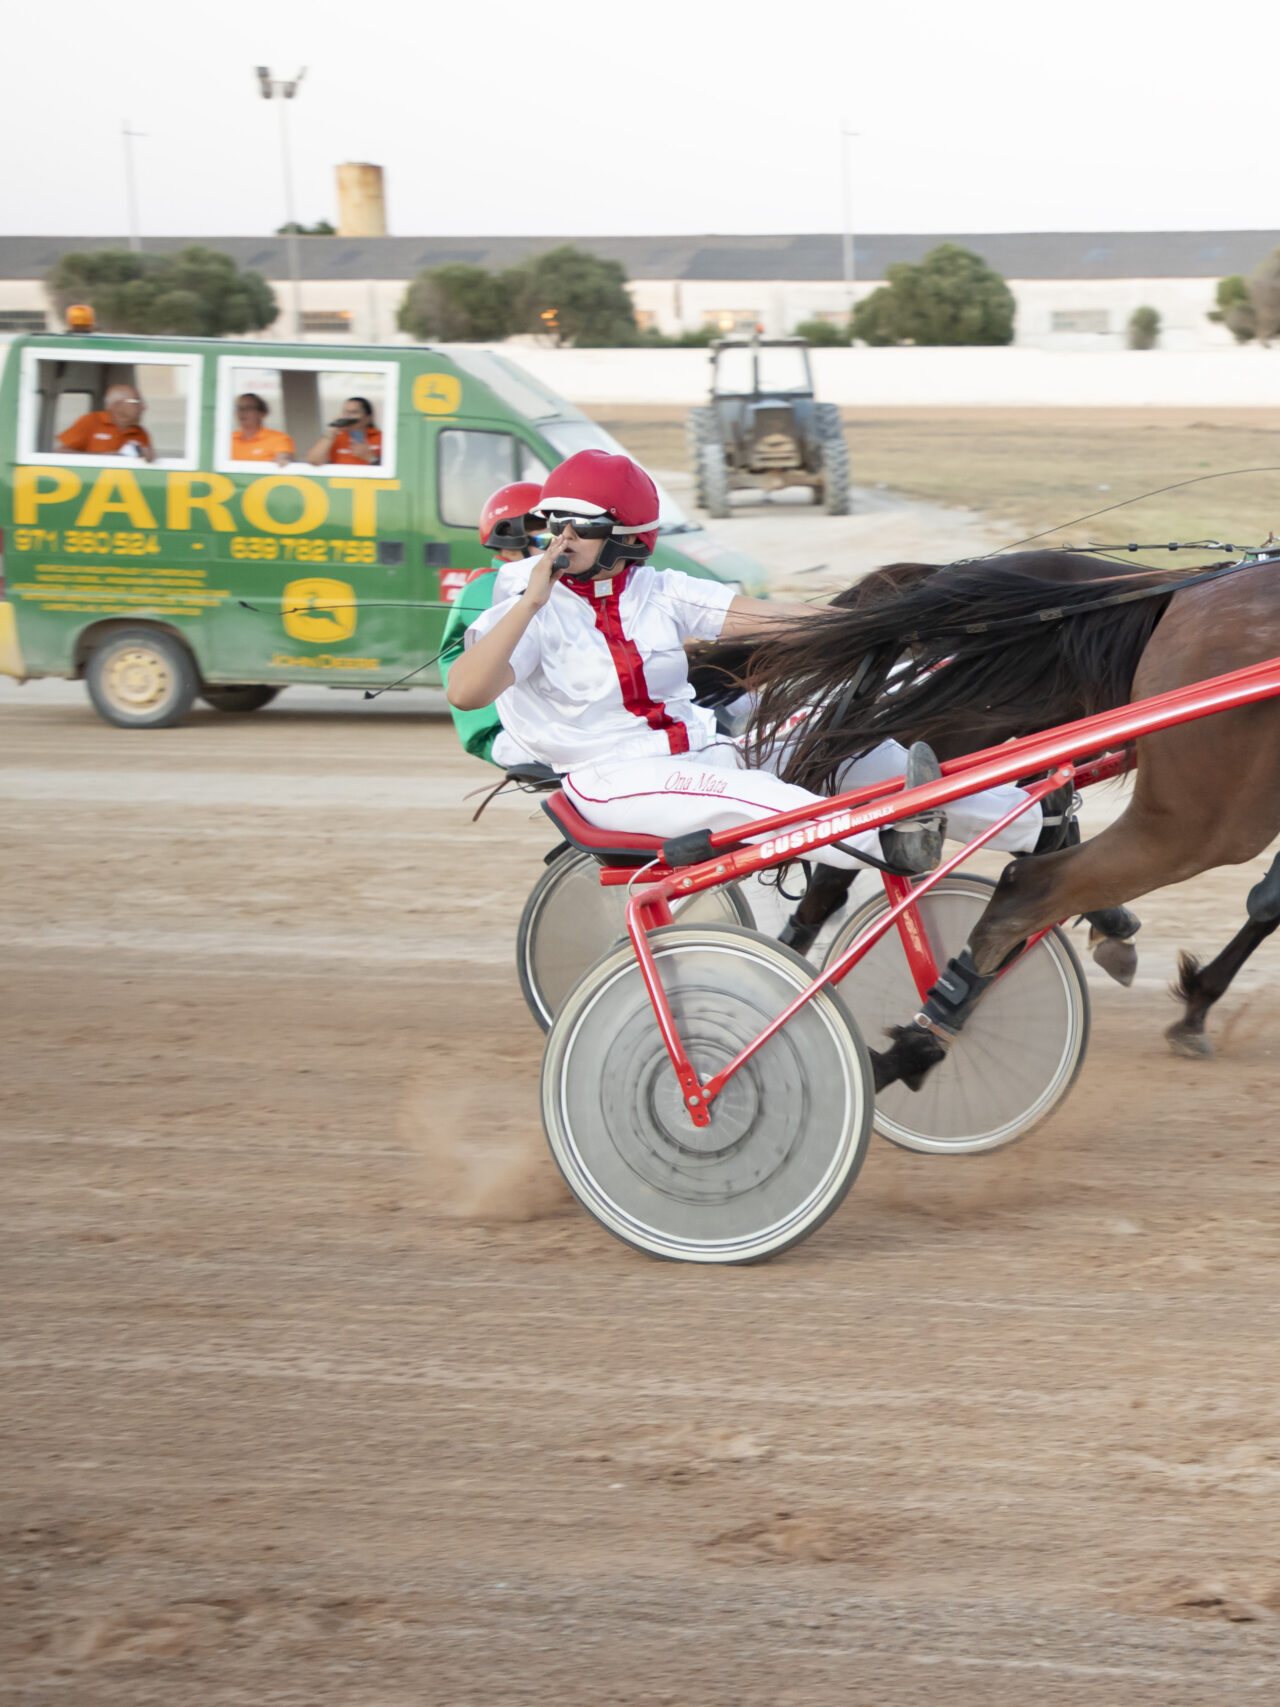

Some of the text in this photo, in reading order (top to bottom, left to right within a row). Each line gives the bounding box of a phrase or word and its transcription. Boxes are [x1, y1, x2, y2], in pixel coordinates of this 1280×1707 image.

[13, 465, 399, 537] PAROT
[664, 770, 693, 791] Ona
[759, 813, 850, 860] CUSTOM
